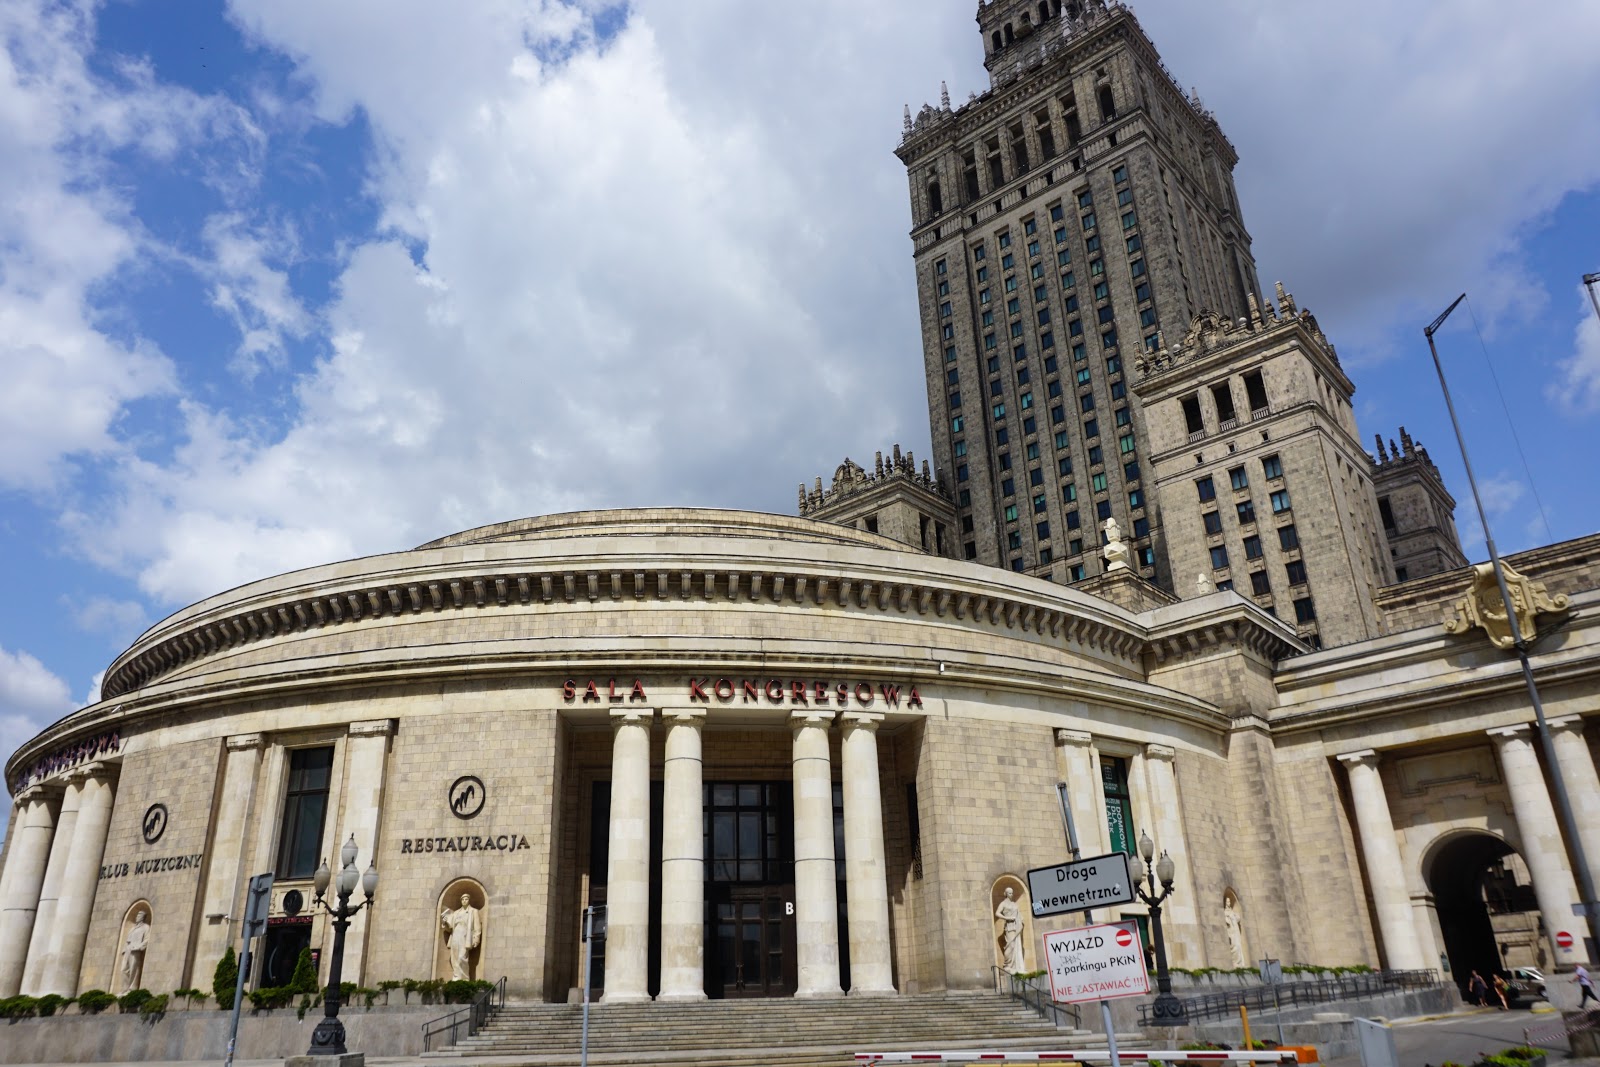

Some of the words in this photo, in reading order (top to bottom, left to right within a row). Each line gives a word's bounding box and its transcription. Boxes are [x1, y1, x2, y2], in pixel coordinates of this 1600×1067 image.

[563, 678, 648, 702] SALA
[689, 677, 924, 708] KONGRESOWA
[401, 834, 530, 853] RESTAURACJA
[99, 863, 129, 880] KLUB
[134, 853, 203, 875] MUZYCZNY
[1056, 866, 1097, 882] Droga
[785, 901, 794, 915] B
[1051, 936, 1104, 954] WYJAZD
[1064, 960, 1107, 976] parkingu
[1109, 955, 1136, 967] PKiN
[1057, 986, 1072, 996] NIE
